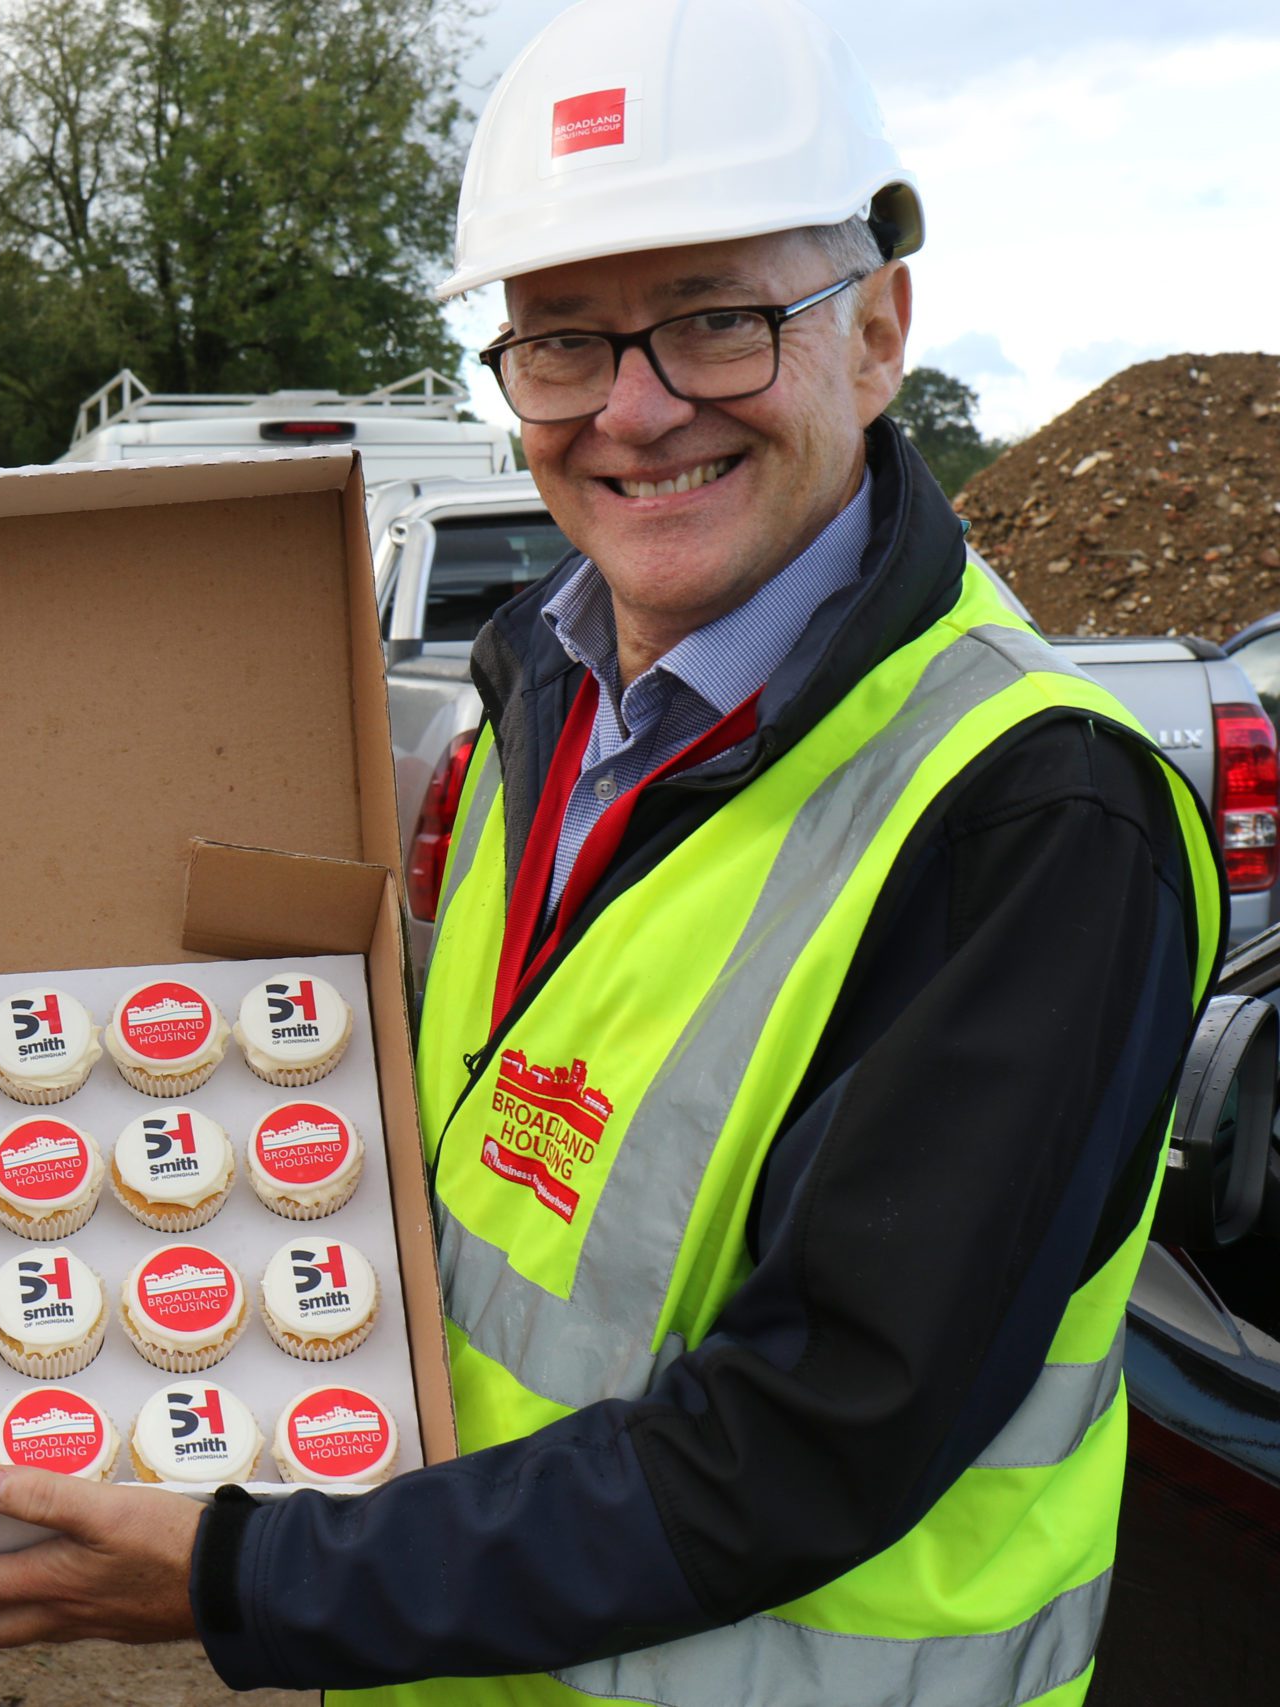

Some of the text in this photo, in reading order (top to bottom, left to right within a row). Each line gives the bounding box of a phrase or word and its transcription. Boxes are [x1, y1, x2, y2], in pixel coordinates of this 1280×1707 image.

[554, 113, 622, 136] BROADLAND
[554, 129, 590, 142] OUSING
[128, 1020, 205, 1037] BROADLAND
[272, 1024, 319, 1039] smith
[18, 1037, 65, 1056] smith
[139, 1032, 196, 1045] HOUSING
[30, 1052, 67, 1060] HONINGHAM
[492, 1091, 595, 1164] BROADLAND
[264, 1143, 342, 1161] BROADLAND
[500, 1120, 574, 1180] HOUSING
[4, 1158, 82, 1179] BROADLAND
[150, 1158, 198, 1175] smith
[275, 1153, 334, 1170] HOUSING
[16, 1170, 74, 1187] HOUSING
[161, 1172, 199, 1180] HONINGHAM
[147, 1288, 229, 1307] BROADLAND
[299, 1293, 349, 1310] smith
[23, 1303, 73, 1321] smith
[159, 1299, 220, 1316] HOUSING
[311, 1307, 351, 1316] HONINGHAM
[35, 1318, 74, 1326] HONINGHAM
[12, 1435, 96, 1452] BROADLAND
[174, 1438, 227, 1455] smith
[298, 1432, 382, 1451] BROADLAND
[24, 1447, 87, 1462] HOUSING
[187, 1454, 228, 1462] HONINGHAM
[309, 1445, 374, 1460] HOUSING
